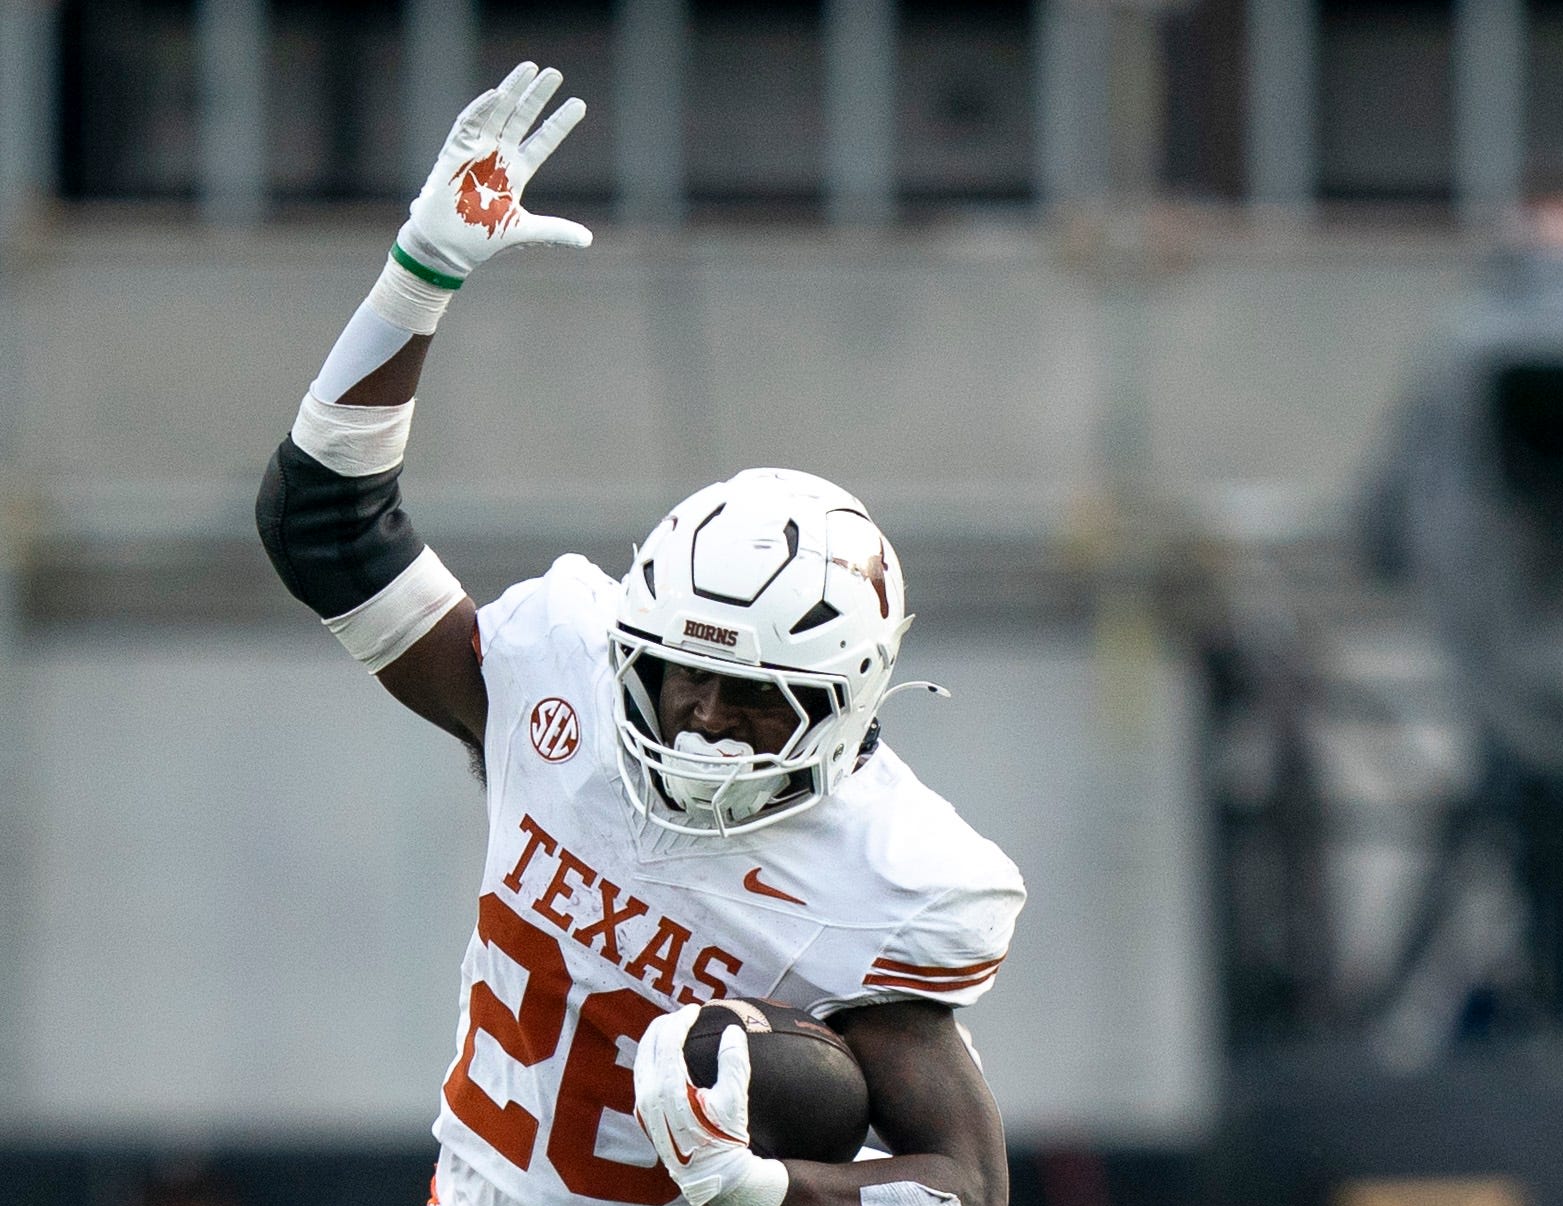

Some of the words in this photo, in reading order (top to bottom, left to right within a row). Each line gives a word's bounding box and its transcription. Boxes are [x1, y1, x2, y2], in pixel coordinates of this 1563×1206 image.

[683, 620, 739, 647] HORNS
[530, 698, 579, 760] SEC
[502, 813, 744, 1004] TEXAS
